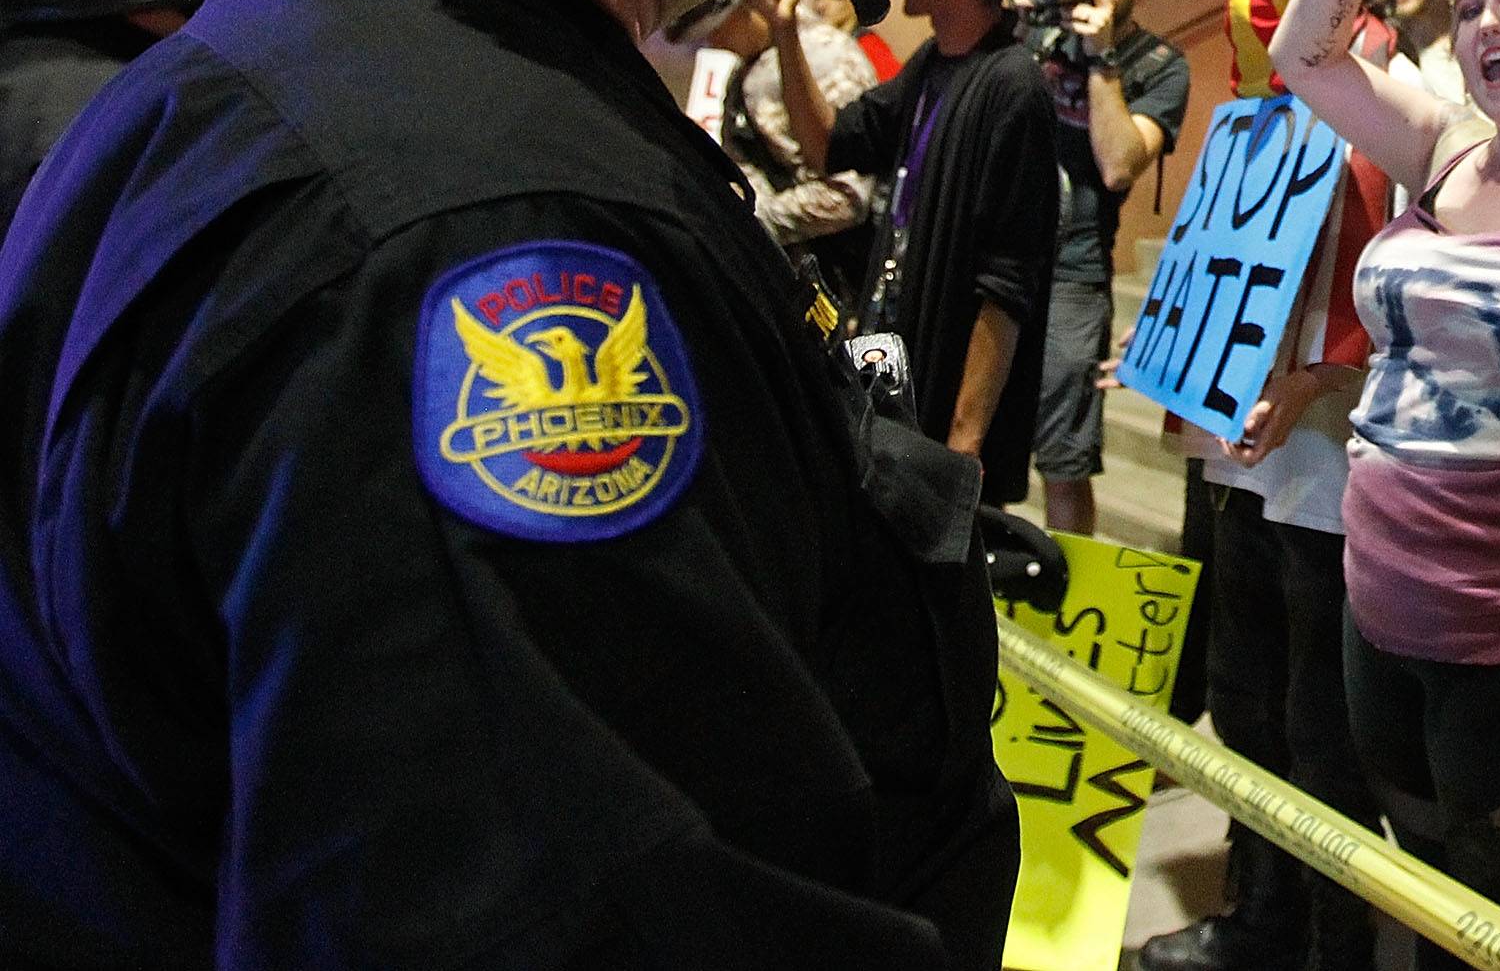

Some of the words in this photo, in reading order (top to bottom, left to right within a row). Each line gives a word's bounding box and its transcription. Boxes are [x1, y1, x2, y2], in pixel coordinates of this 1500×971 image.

[1172, 105, 1338, 244] STOP
[476, 271, 625, 326] POLICE
[1124, 251, 1285, 419] HATE
[472, 402, 666, 451] PHOENIX
[512, 456, 655, 505] ARIZONA
